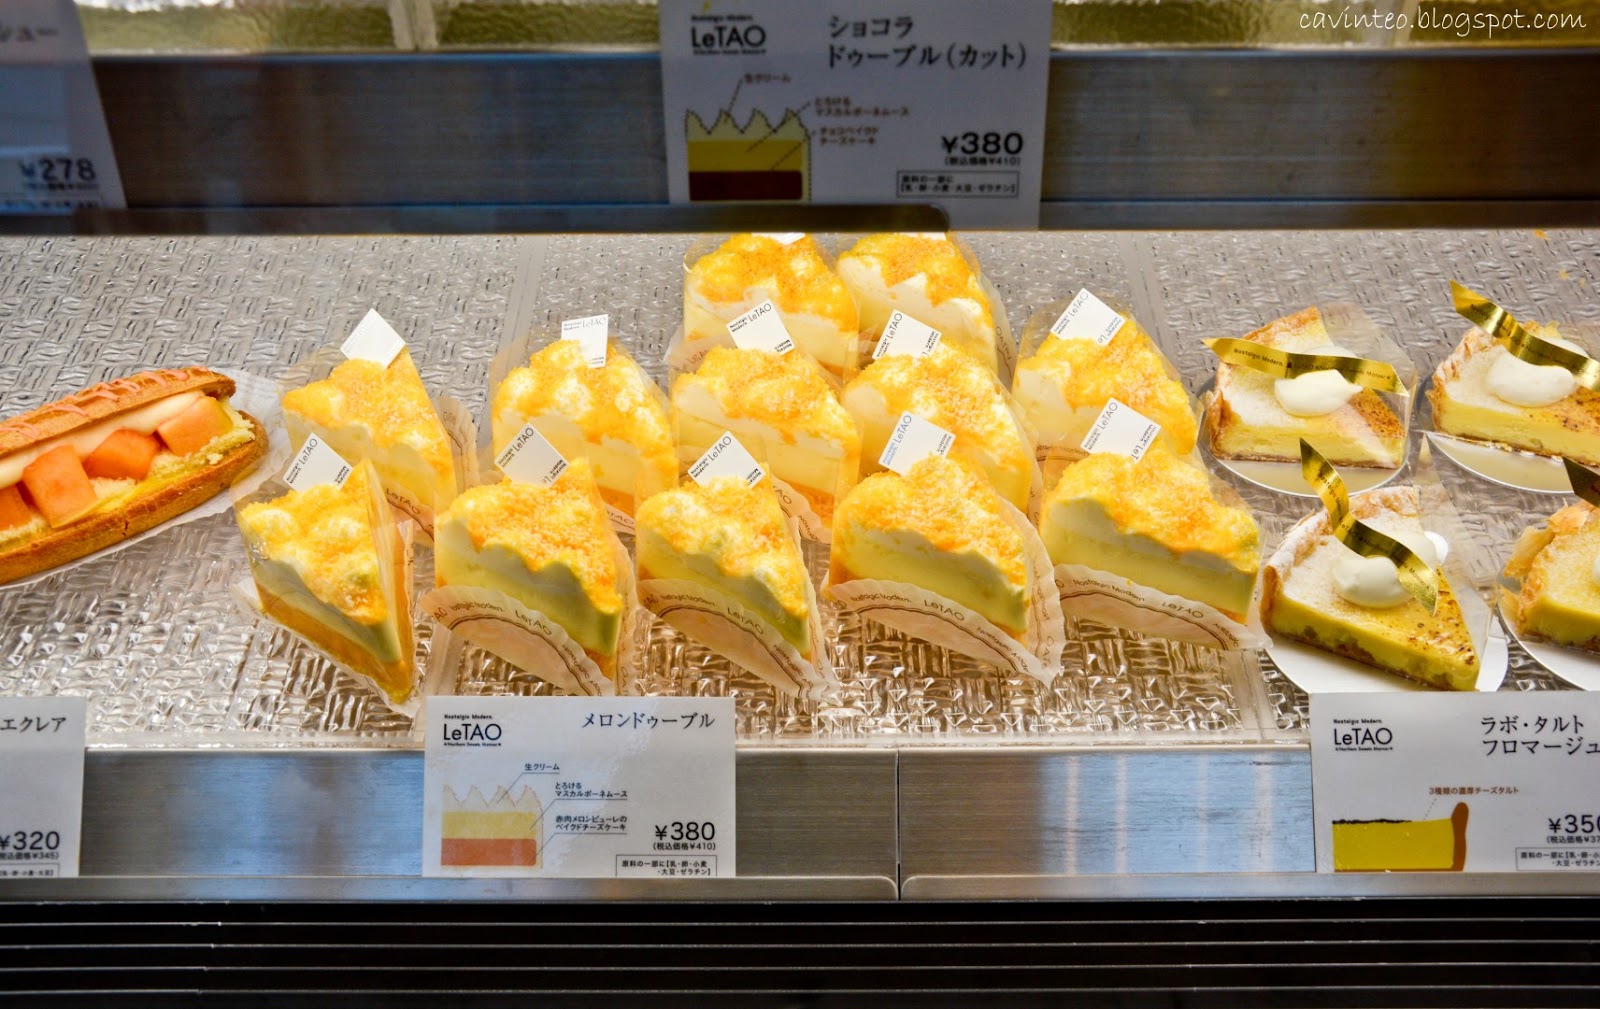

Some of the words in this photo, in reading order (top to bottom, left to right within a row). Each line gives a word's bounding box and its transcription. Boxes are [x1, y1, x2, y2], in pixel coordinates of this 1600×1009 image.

[691, 25, 766, 47] LeTAO
[829, 15, 914, 39] ショコラ
[941, 132, 1024, 155] ¥380
[747, 303, 772, 322] LeTAO
[1068, 292, 1089, 317] LeTAO
[582, 317, 607, 328] LeTAO
[886, 313, 903, 339] LeTAO
[1233, 347, 1261, 361] Nostalgic
[1097, 402, 1118, 430] LeTAO
[893, 414, 912, 444] LeTAO
[512, 427, 534, 452] LeTAO
[707, 436, 732, 462] LeTAO
[298, 438, 318, 465] LeTAO
[385, 487, 421, 515] LeTAO
[1072, 578, 1112, 590] Nostalgic
[923, 599, 965, 622] LeTAO
[1161, 601, 1204, 619] LeTAO
[514, 608, 552, 636] LeTAO
[727, 607, 764, 635] LeTAO
[444, 713, 470, 721] Nostalgic
[581, 712, 716, 730] メロンドゥーブル
[1333, 718, 1360, 726] Nostalgic
[1481, 714, 1585, 735] ラボ・タルト
[443, 723, 502, 741] LeTAO
[1333, 727, 1393, 745] LeTAO
[524, 762, 560, 771] 生クリーム
[555, 781, 583, 790] とろける
[1429, 787, 1520, 796] 3種類の濃厚チーズタルト
[654, 821, 715, 841] ¥380
[1548, 813, 1600, 834] ¥35
[0, 830, 61, 850] ¥320
[652, 842, 716, 851] (税込価格¥410)
